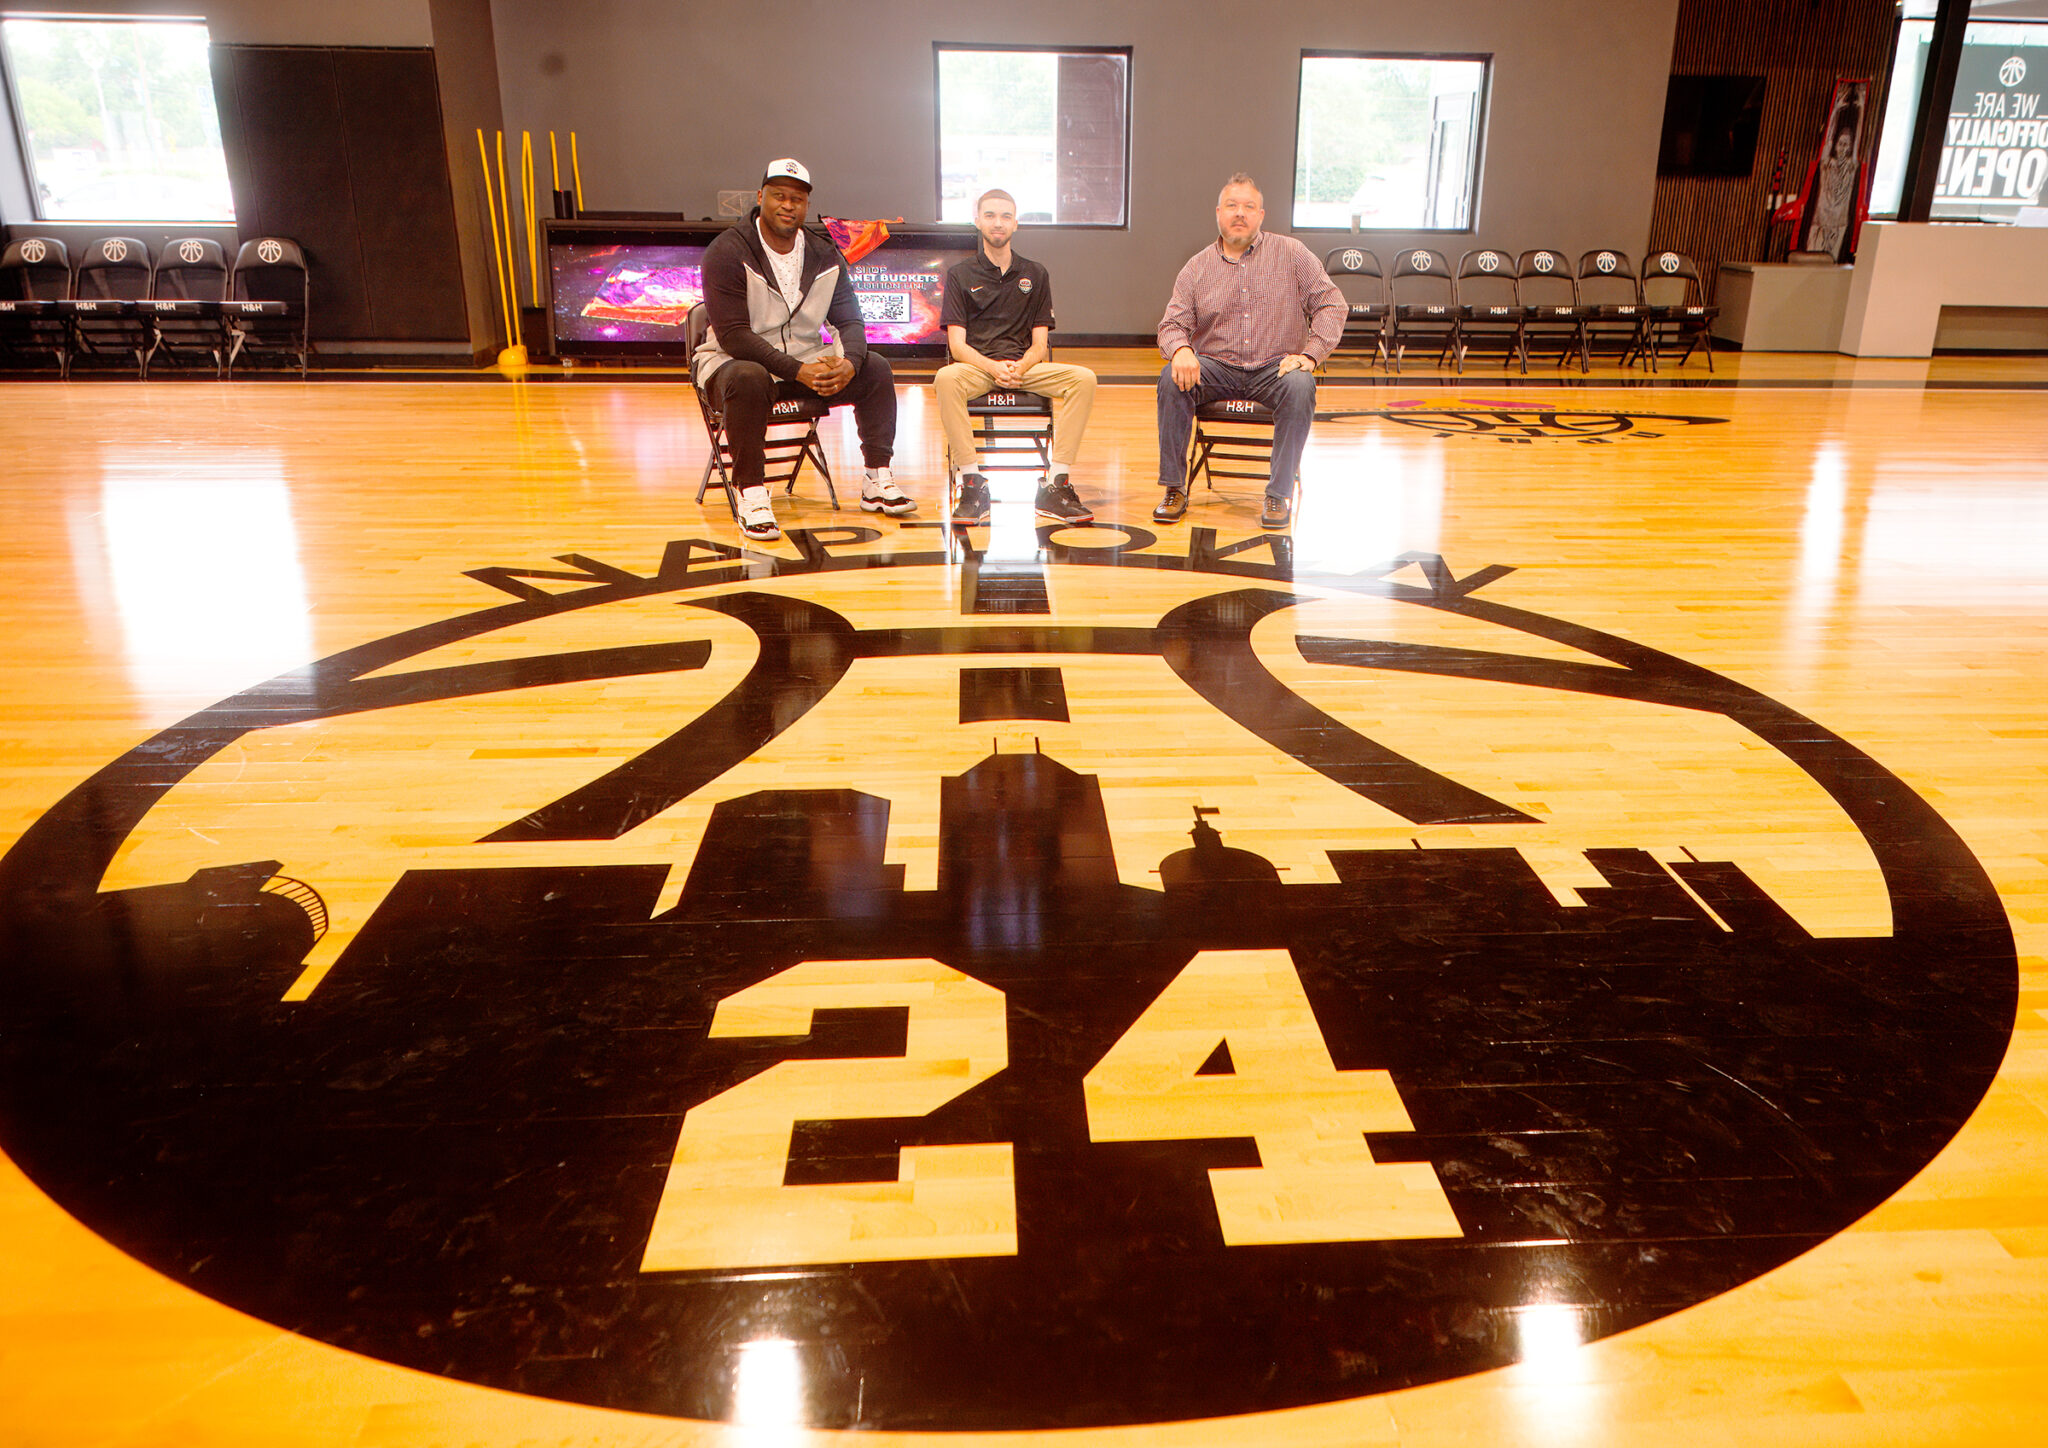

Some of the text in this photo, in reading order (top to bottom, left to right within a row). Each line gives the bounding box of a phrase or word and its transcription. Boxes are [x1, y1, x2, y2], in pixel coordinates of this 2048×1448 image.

[879, 273, 940, 283] BUCKETS
[76, 302, 97, 311] H&H
[155, 302, 176, 311] H&H
[241, 303, 263, 312] H&H
[1352, 305, 1370, 313] H&H
[1427, 306, 1445, 314] H&H
[1490, 306, 1508, 315] H&H
[1555, 307, 1573, 315] H&H
[1618, 306, 1635, 314] H&H
[1687, 307, 1704, 315] H&H
[987, 394, 1015, 406] H&H
[772, 401, 800, 415] H&H
[1226, 400, 1254, 413] H&H
[461, 522, 1517, 600] NAPTOWN
[640, 948, 1464, 1273] 24
